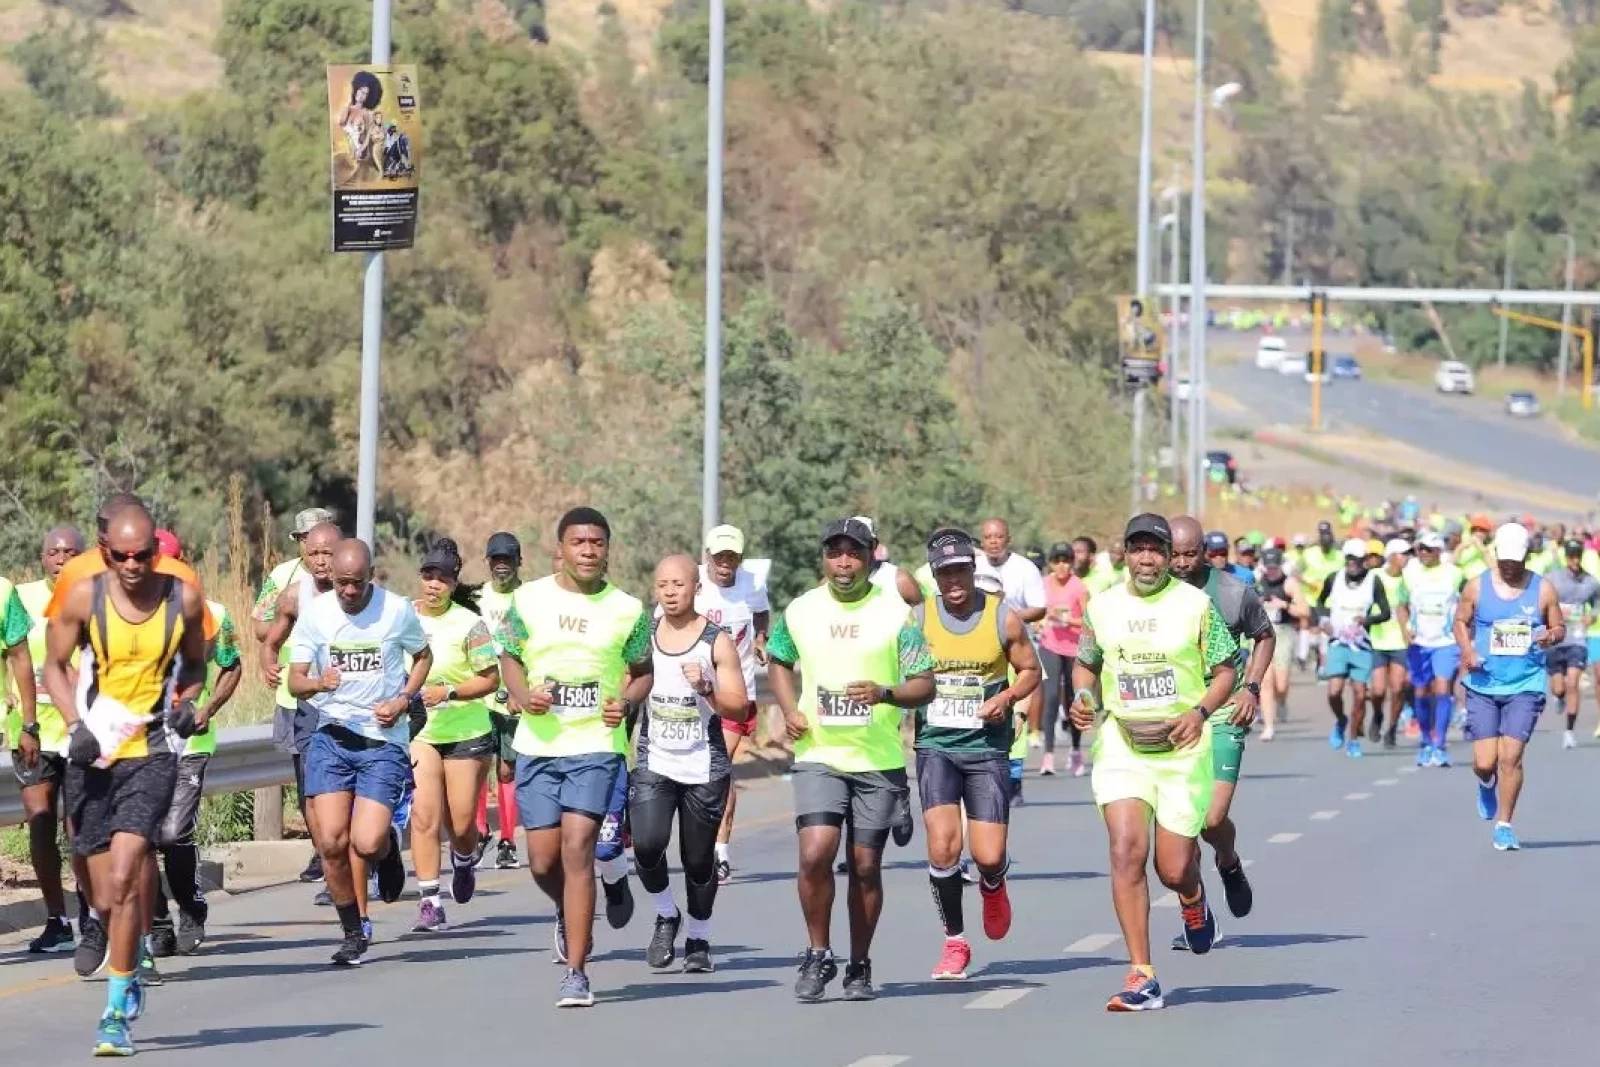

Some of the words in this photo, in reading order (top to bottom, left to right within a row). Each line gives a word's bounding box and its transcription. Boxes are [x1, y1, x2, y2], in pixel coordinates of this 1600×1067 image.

[558, 614, 588, 633] WE
[829, 624, 860, 639] WE
[1127, 618, 1158, 633] WE
[557, 685, 599, 707] 15803
[1133, 674, 1176, 699] 11489
[942, 699, 982, 718] 2146
[661, 720, 701, 740] 25675
